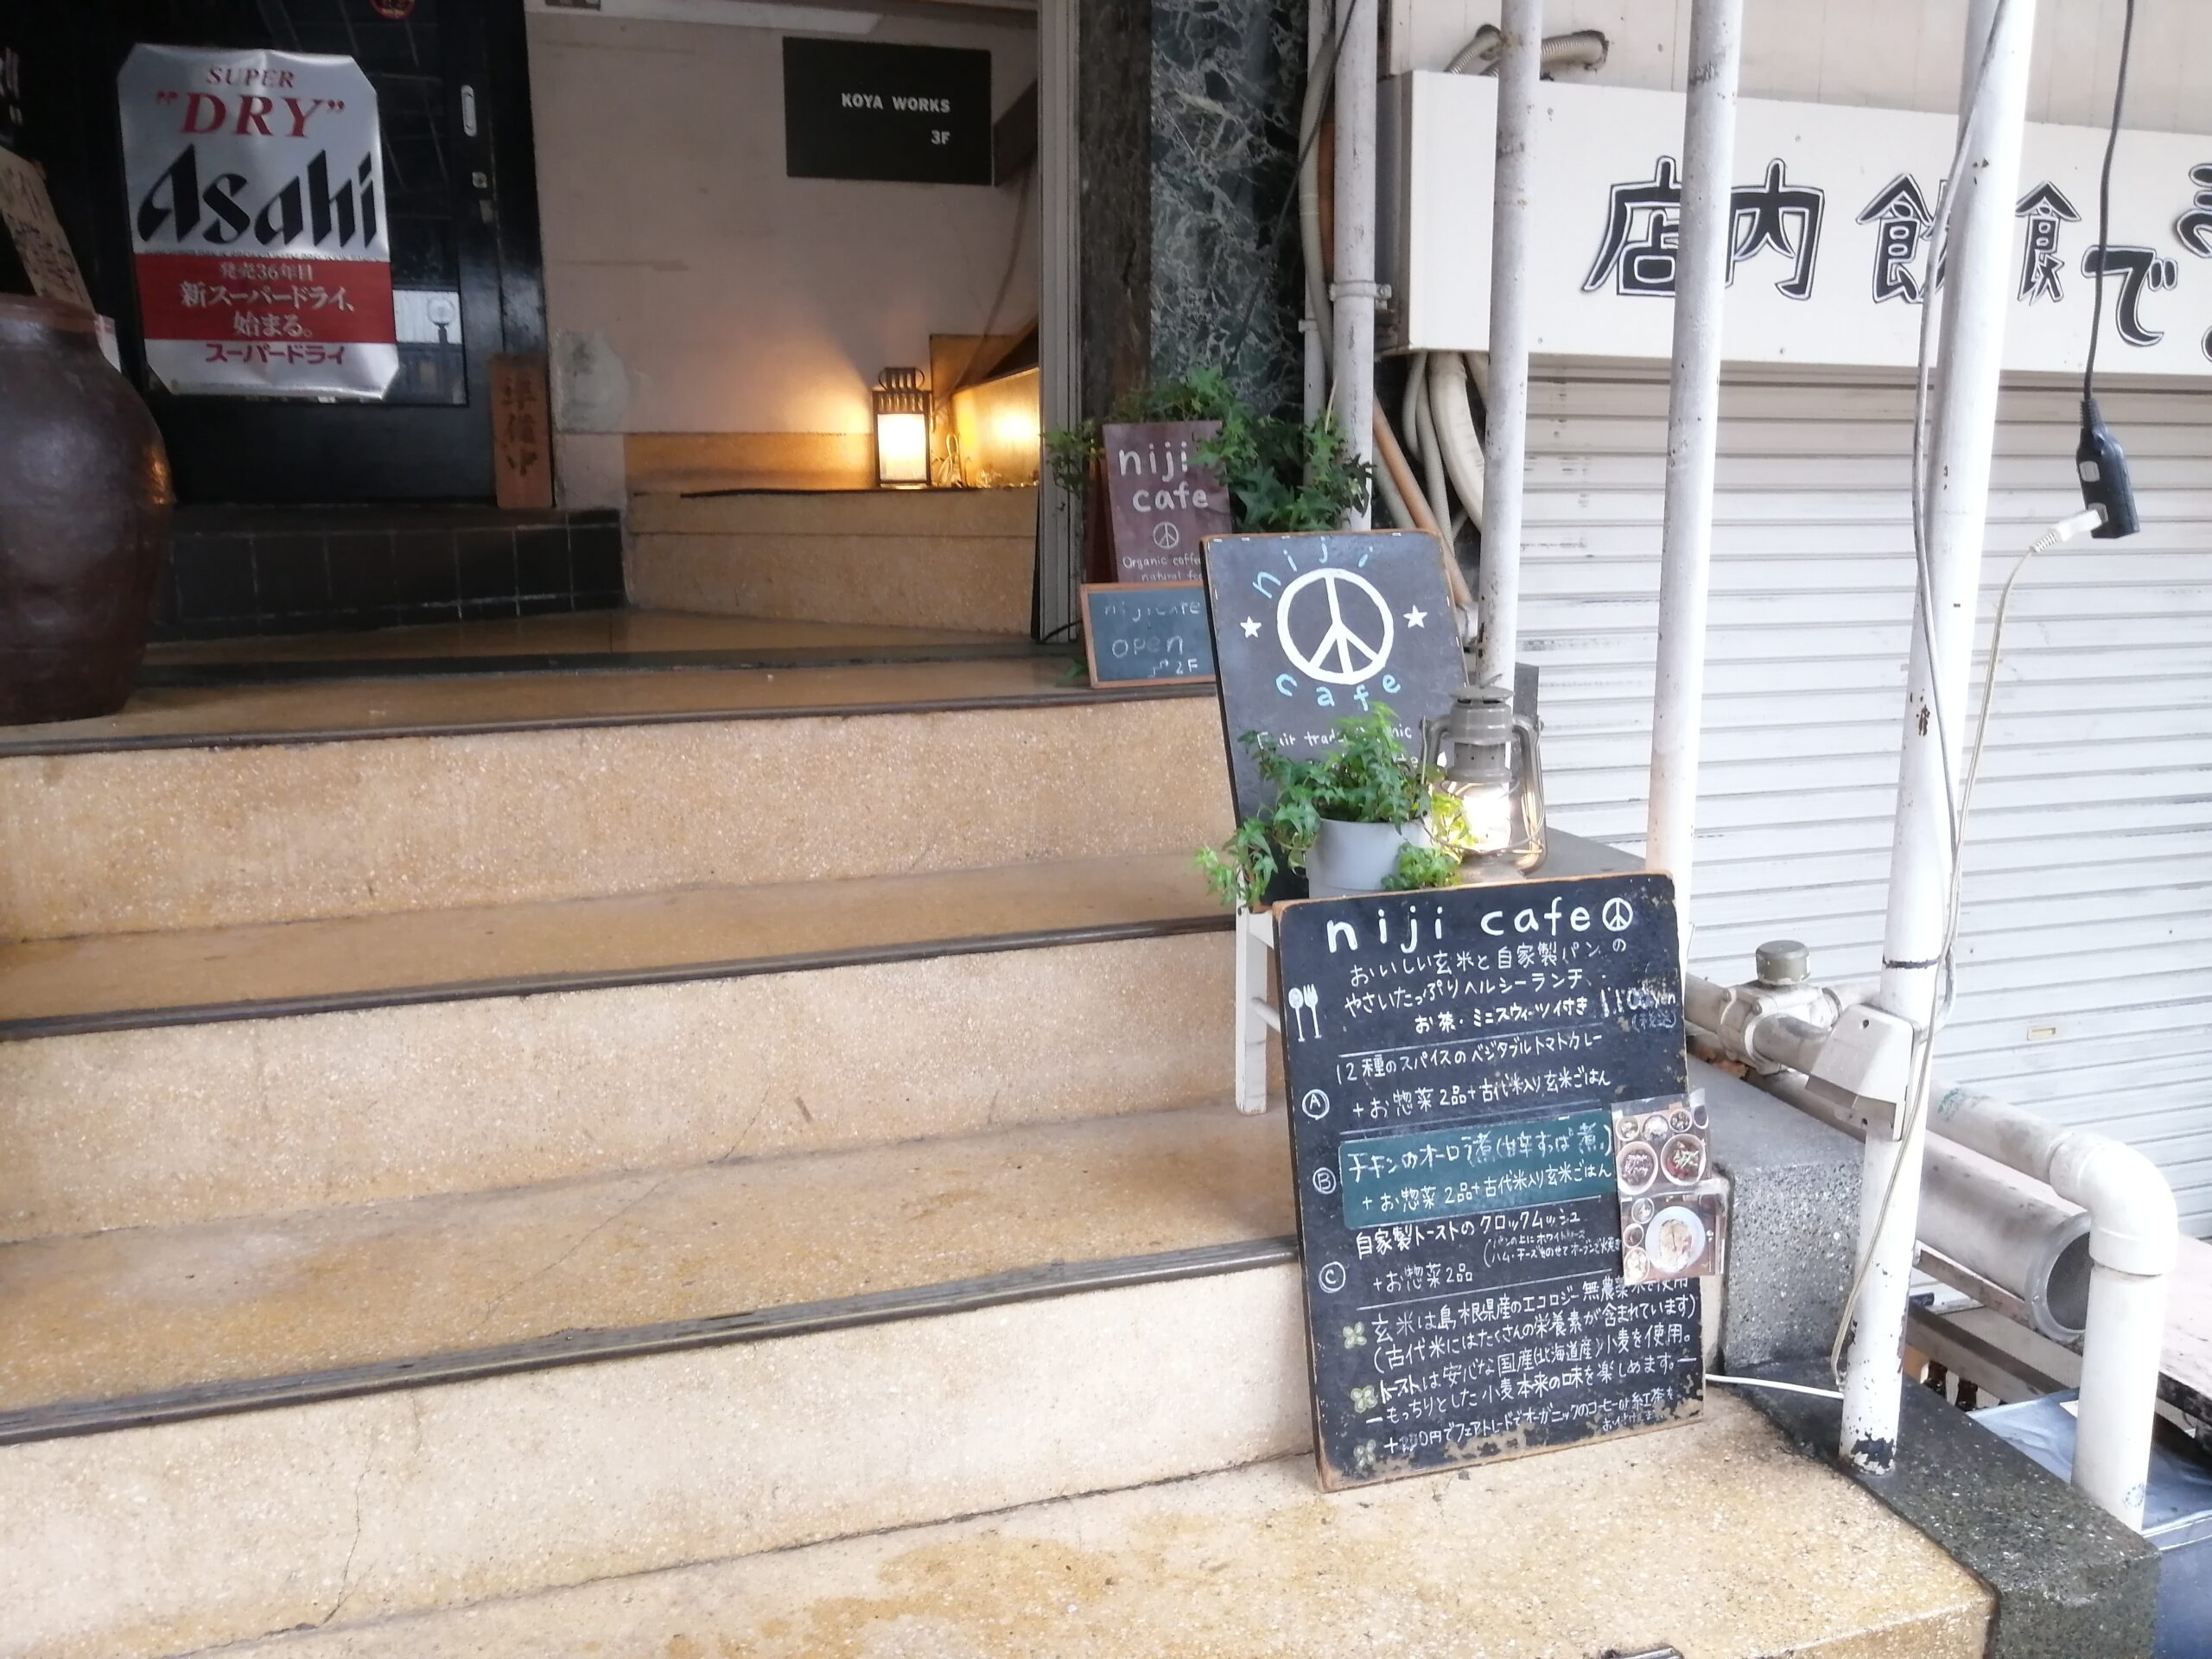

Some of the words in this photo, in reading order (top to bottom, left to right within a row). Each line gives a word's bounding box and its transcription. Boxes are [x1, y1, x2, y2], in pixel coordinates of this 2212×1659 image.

[207, 67, 295, 88] SUPER
[842, 92, 884, 110] KOYA
[892, 96, 950, 113] WORKS
[931, 130, 950, 145] 3F
[137, 143, 378, 249] Asahi
[219, 264, 313, 282] 発売36年目
[233, 311, 313, 338] 始まる。
[205, 343, 345, 365] スーパードライ
[1119, 441, 1188, 483] niji
[1133, 480, 1209, 512] cafe
[1123, 556, 1166, 570] Organic
[1253, 536, 1374, 599] niji
[1275, 673, 1402, 711] cafe
[1326, 906, 1443, 953] niji
[1480, 896, 1591, 936] cafe
